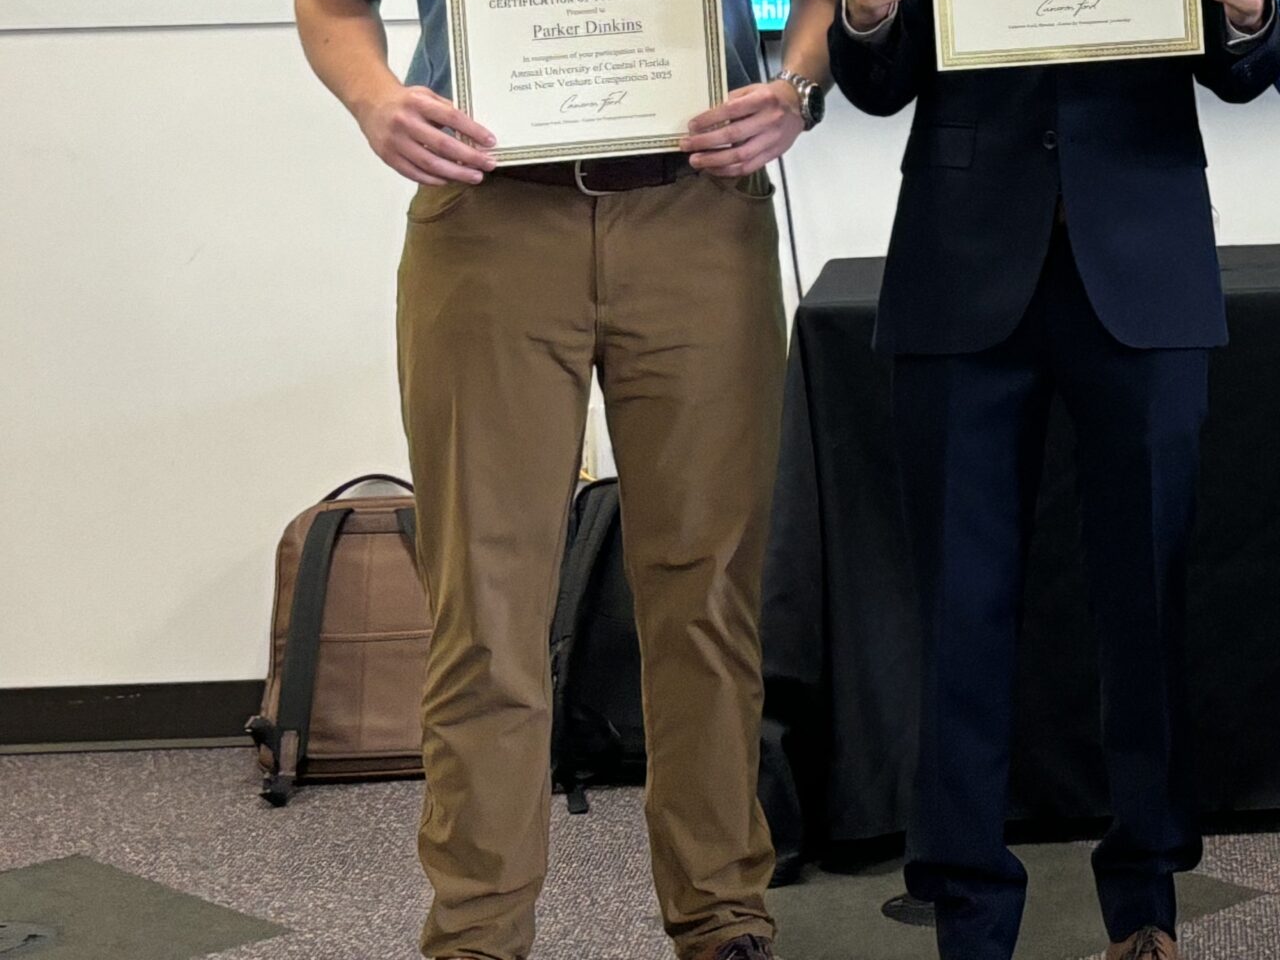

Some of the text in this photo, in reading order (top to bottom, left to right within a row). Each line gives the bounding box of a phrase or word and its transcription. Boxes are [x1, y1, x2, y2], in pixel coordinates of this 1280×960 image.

[532, 20, 643, 38] Parker Dinkins
[592, 63, 603, 72] of
